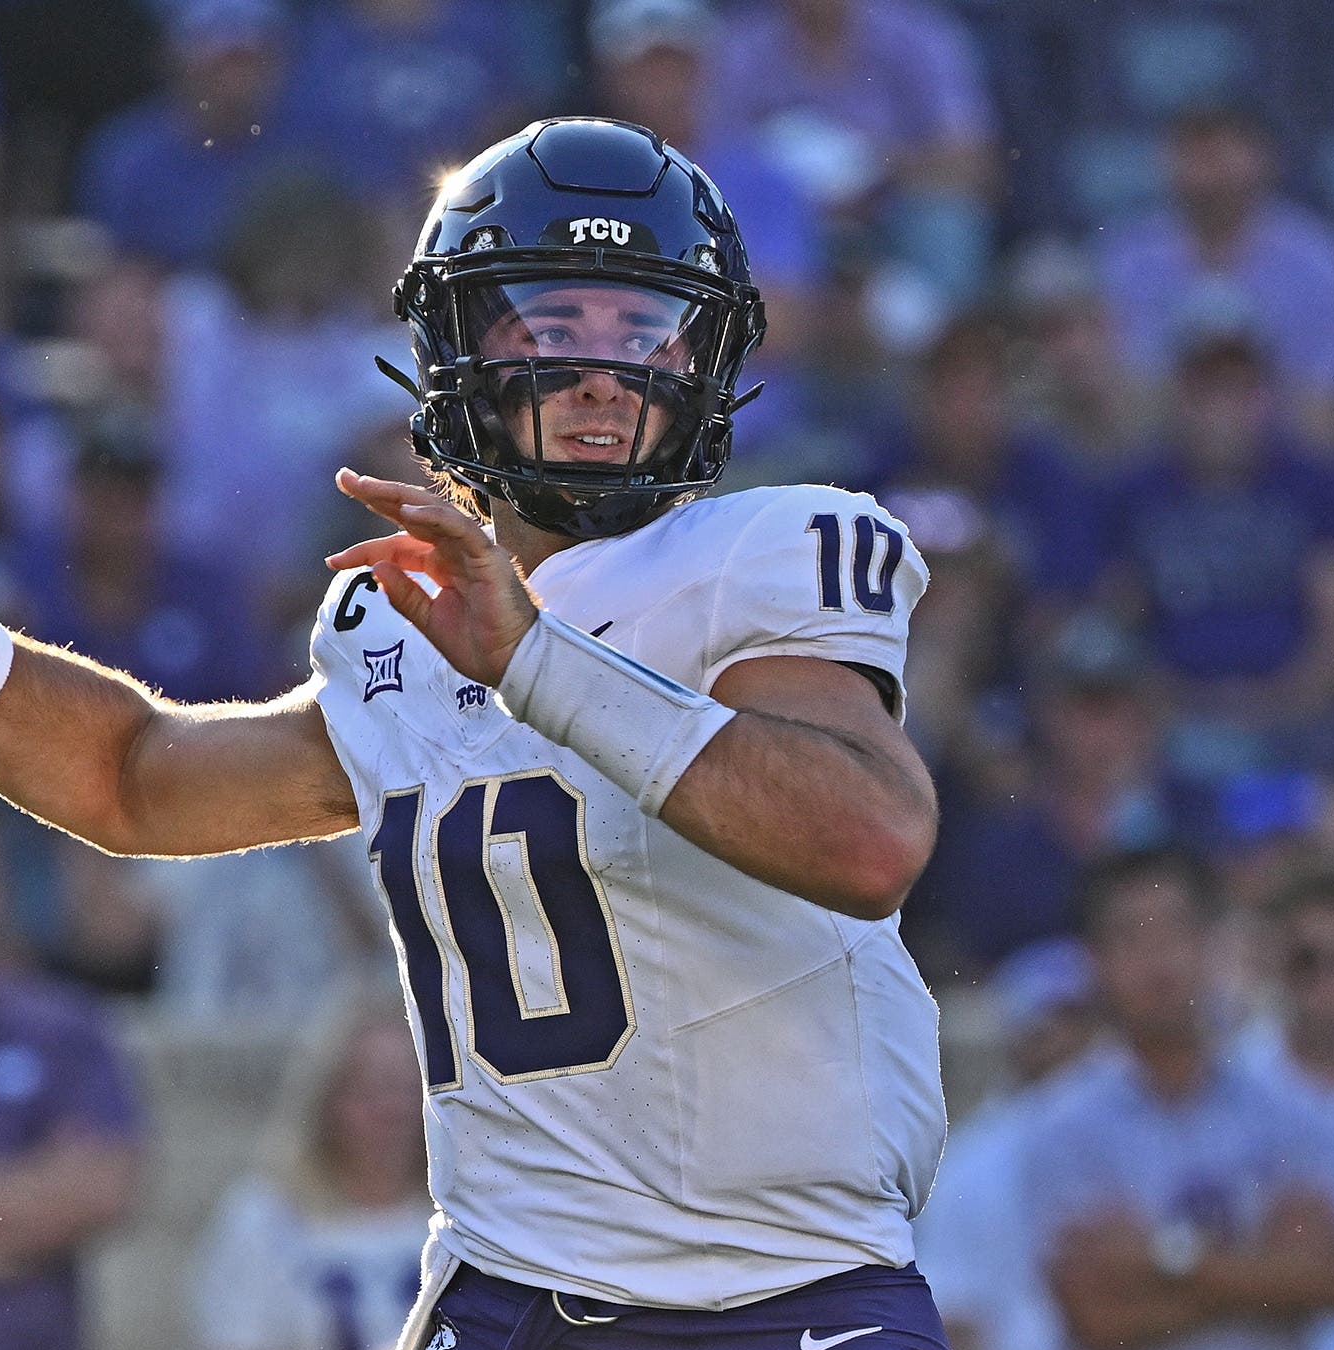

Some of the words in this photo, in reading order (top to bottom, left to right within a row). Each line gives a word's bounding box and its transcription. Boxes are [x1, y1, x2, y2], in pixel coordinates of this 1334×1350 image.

[569, 217, 632, 246] TCU
[804, 512, 905, 617] 10
[333, 571, 378, 632] C
[455, 684, 487, 712] TCU
[367, 766, 637, 1095] 10
